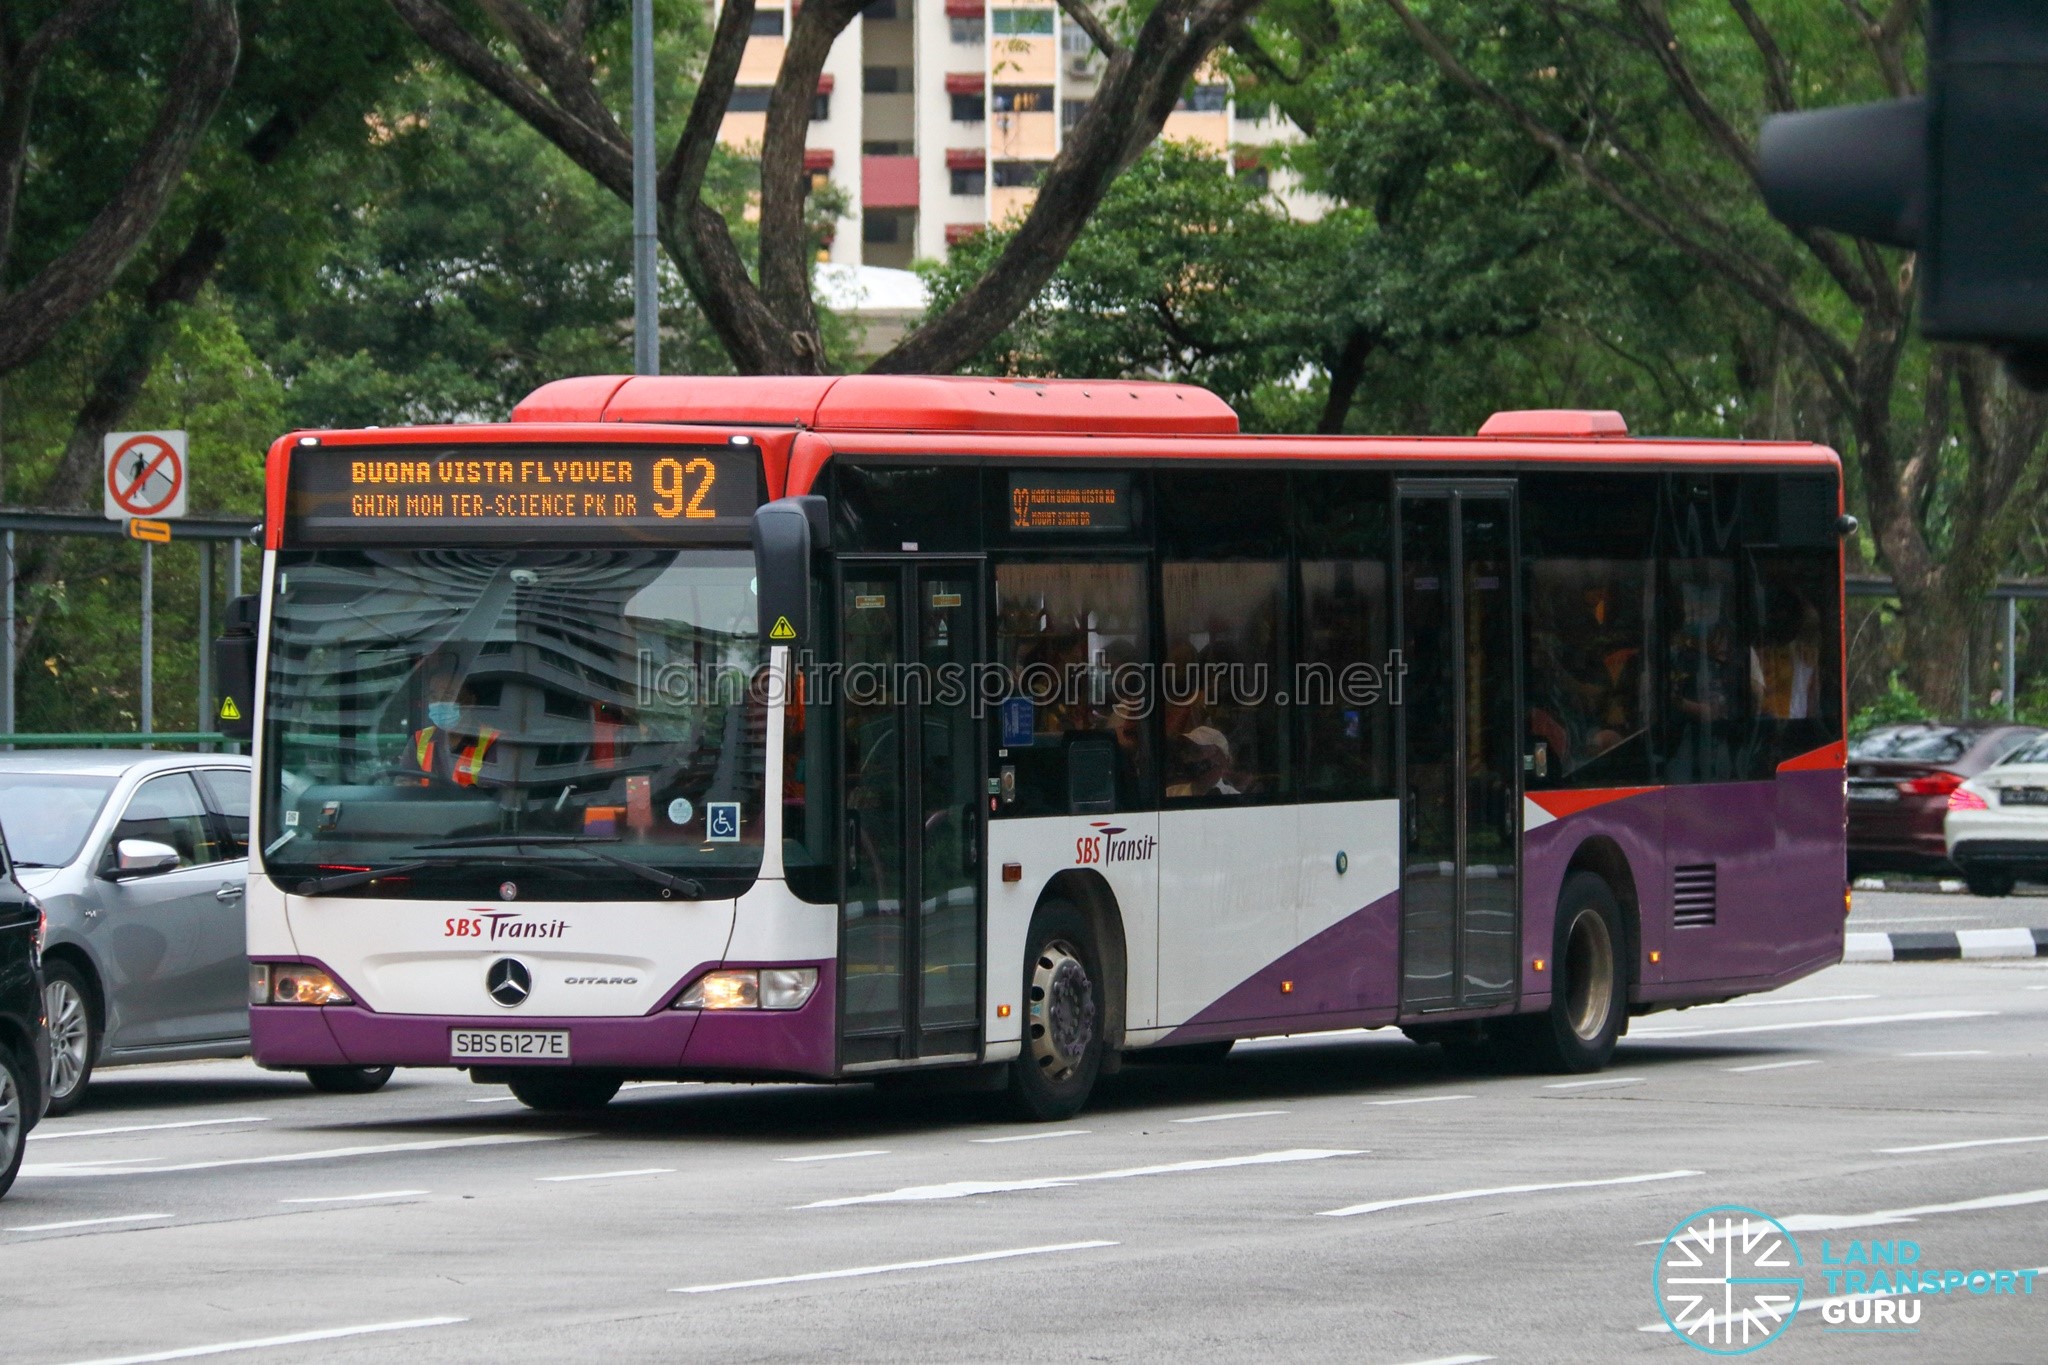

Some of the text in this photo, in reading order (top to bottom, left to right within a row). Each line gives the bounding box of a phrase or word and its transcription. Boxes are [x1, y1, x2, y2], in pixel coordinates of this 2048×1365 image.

[352, 461, 632, 483] BUONA VISTA FLYOVER
[652, 458, 716, 519] 92
[352, 494, 637, 517] GHIM MOH TER-SCIENCE PK DR
[1075, 827, 1158, 868] SBS Transit
[444, 913, 573, 942] SBS Transit
[456, 1033, 564, 1054] SBS6127E
